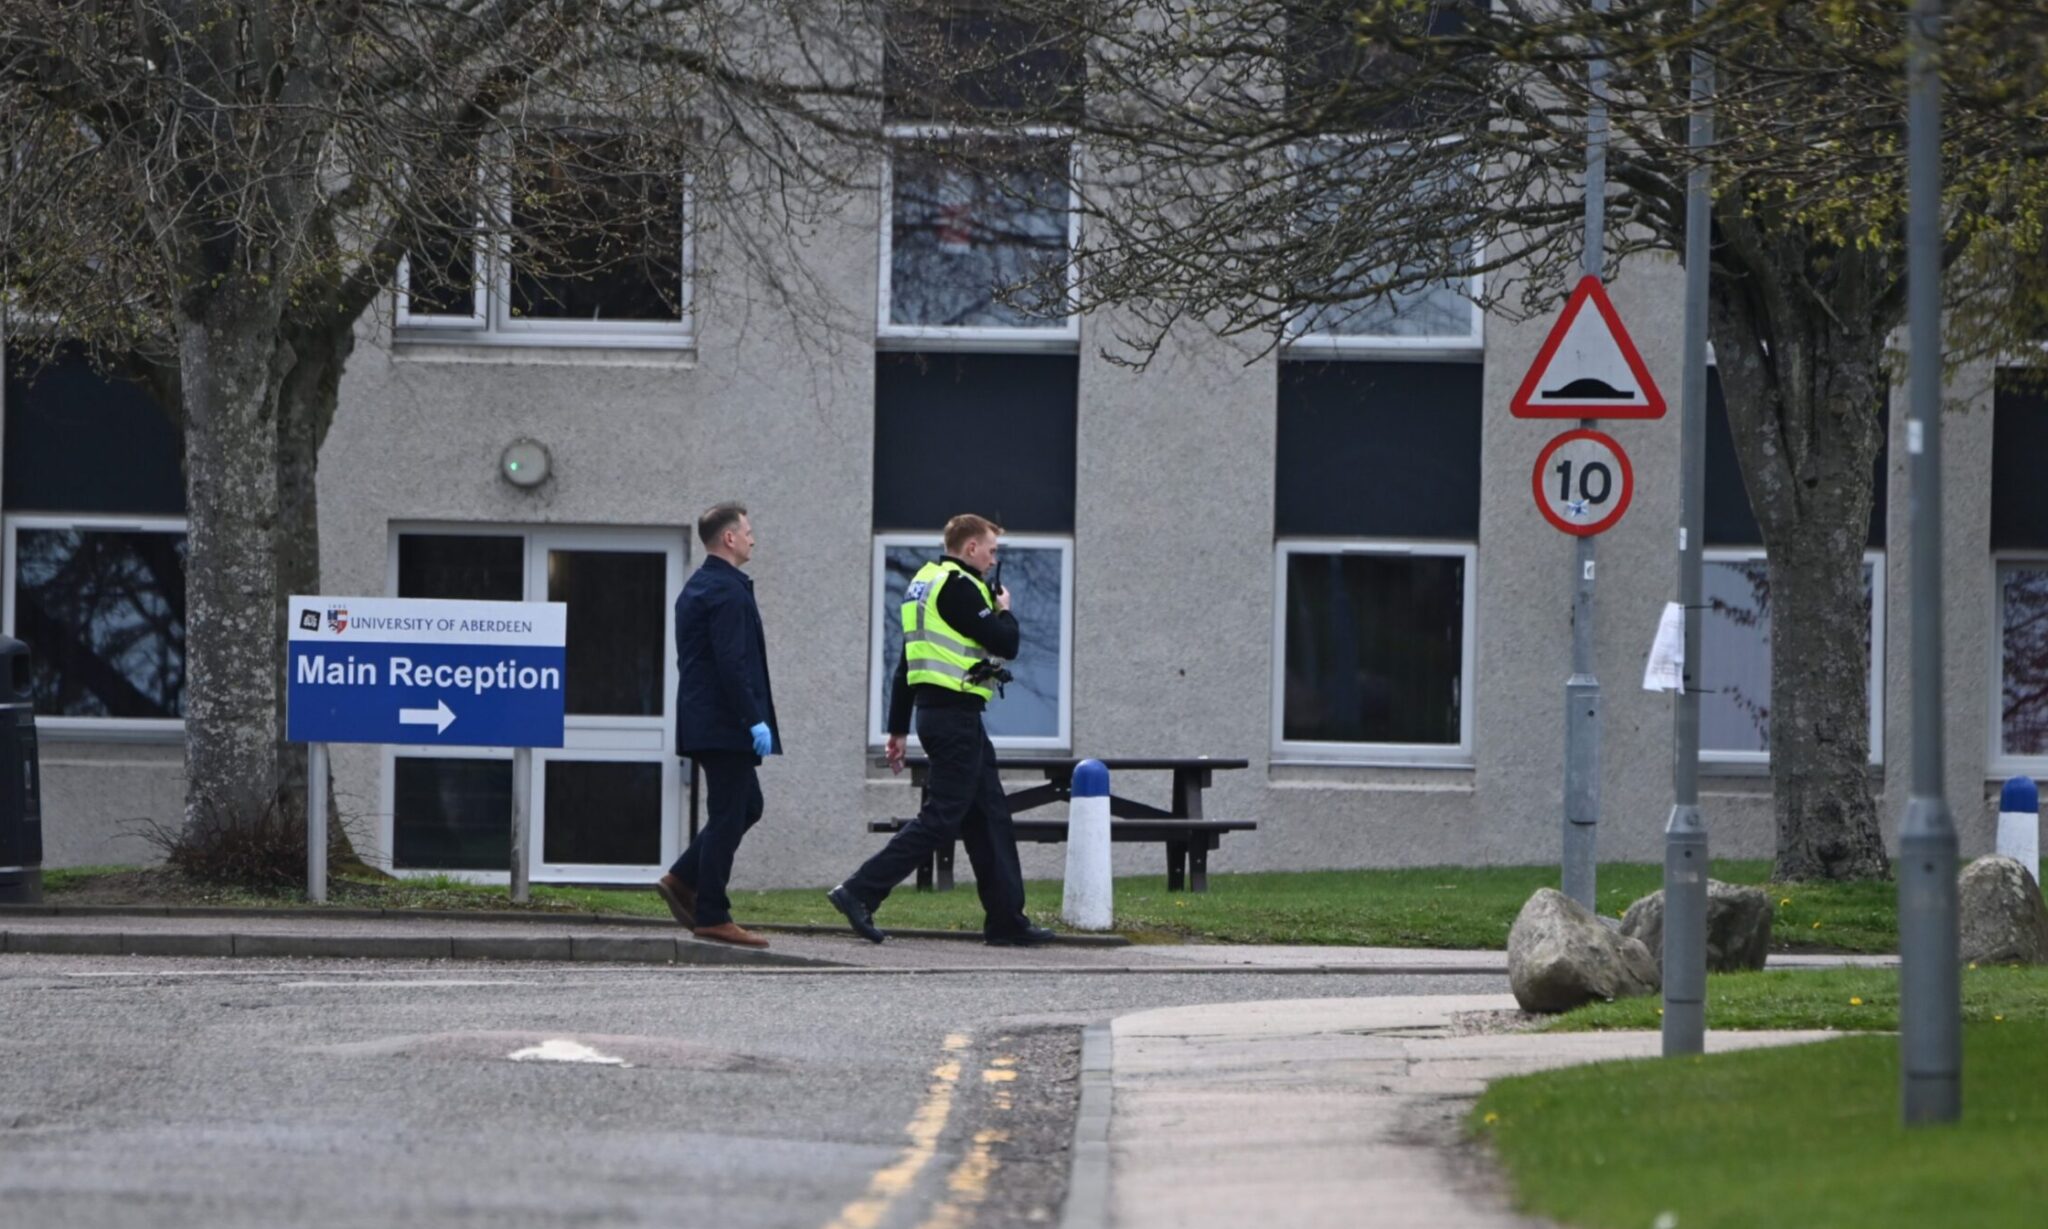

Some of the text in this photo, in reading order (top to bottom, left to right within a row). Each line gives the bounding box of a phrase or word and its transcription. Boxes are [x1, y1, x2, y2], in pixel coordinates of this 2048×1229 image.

[1556, 460, 1612, 504] 10
[351, 617, 532, 633] UNIVERSITY OF ABERDEEN
[297, 655, 560, 695] Main Reception
